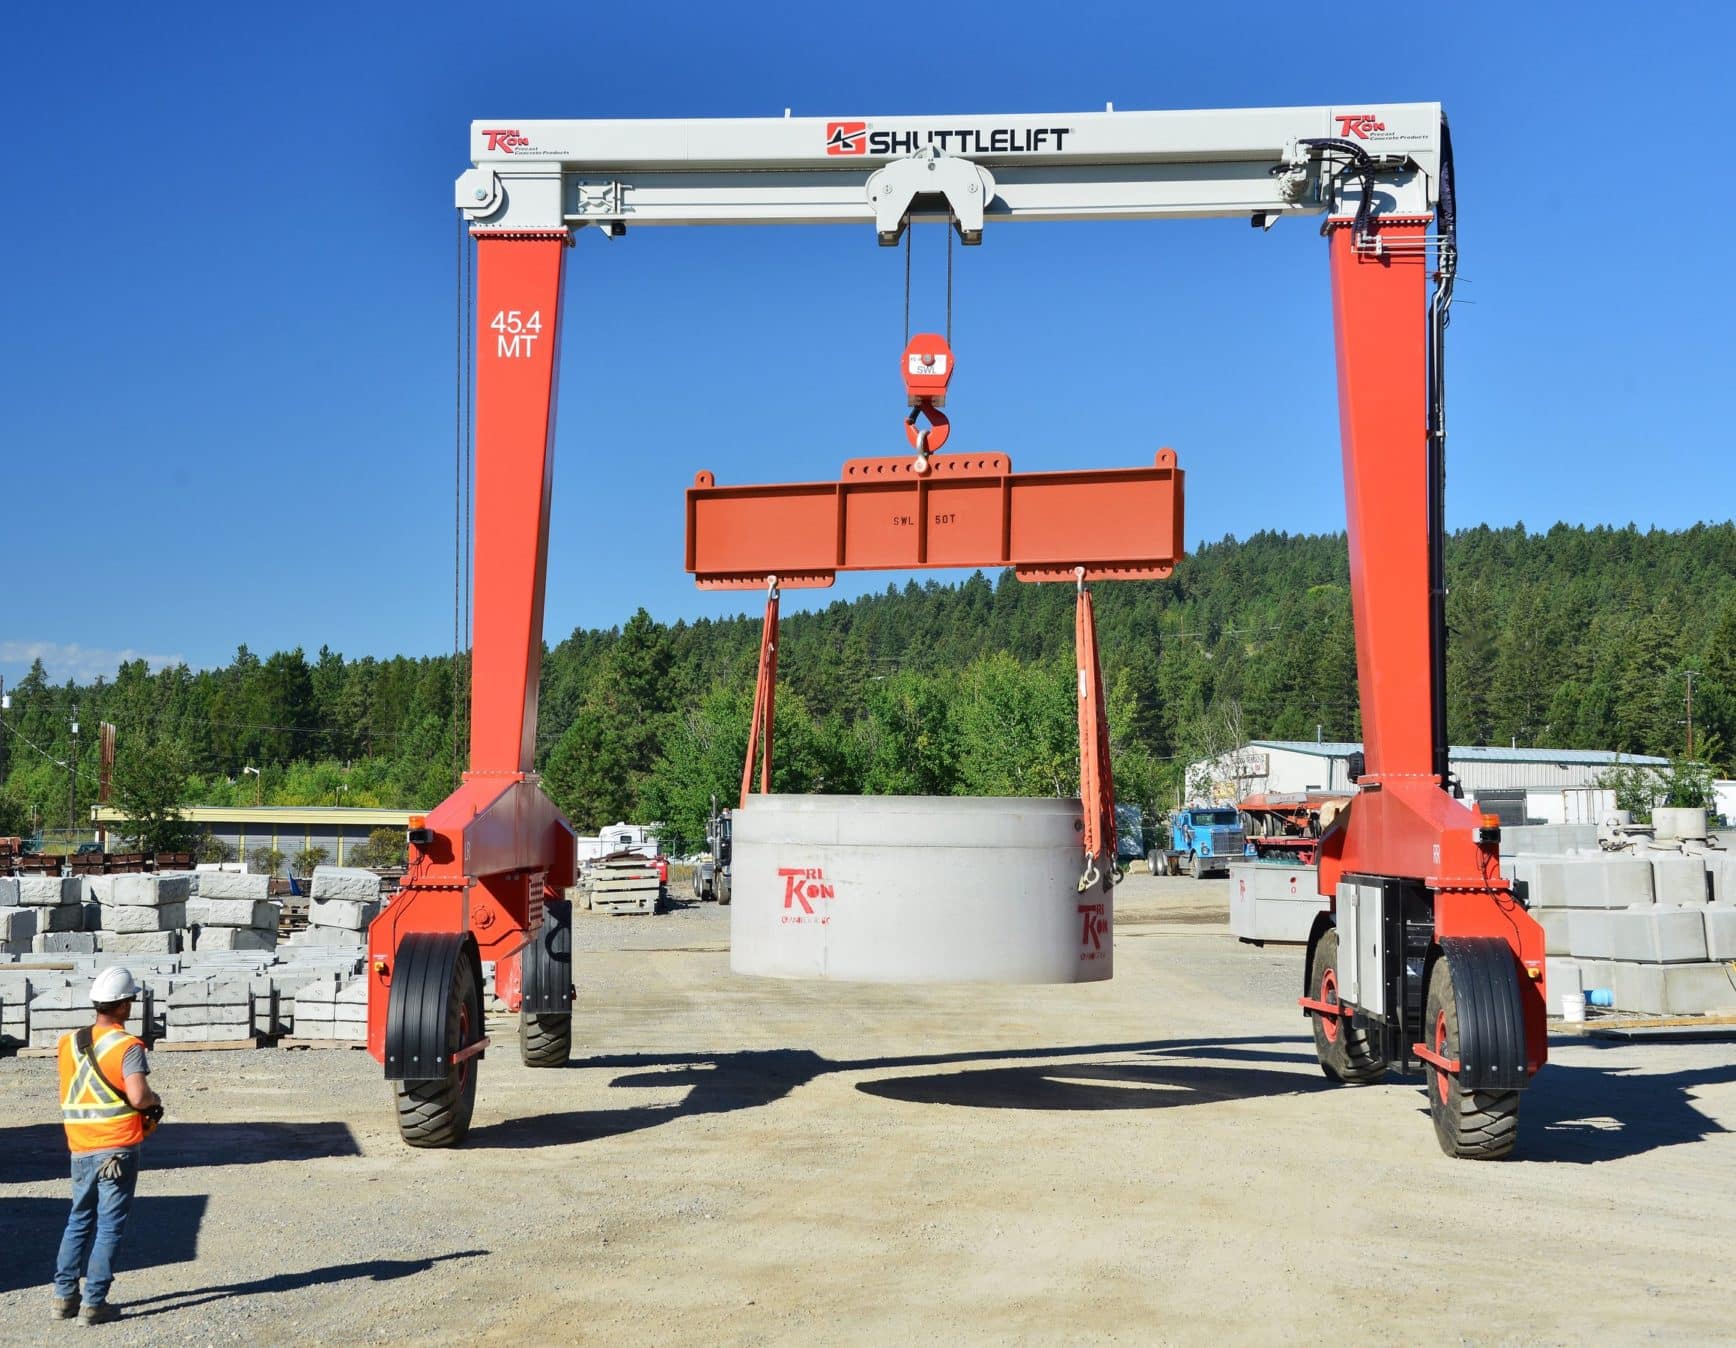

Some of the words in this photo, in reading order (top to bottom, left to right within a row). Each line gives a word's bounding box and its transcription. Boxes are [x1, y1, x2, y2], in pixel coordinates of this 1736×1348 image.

[869, 128, 1070, 154] SHUTTLELIFT
[490, 310, 542, 333] 45.4
[498, 335, 538, 358] MT
[893, 516, 914, 526] SWL
[935, 514, 956, 525] 50T
